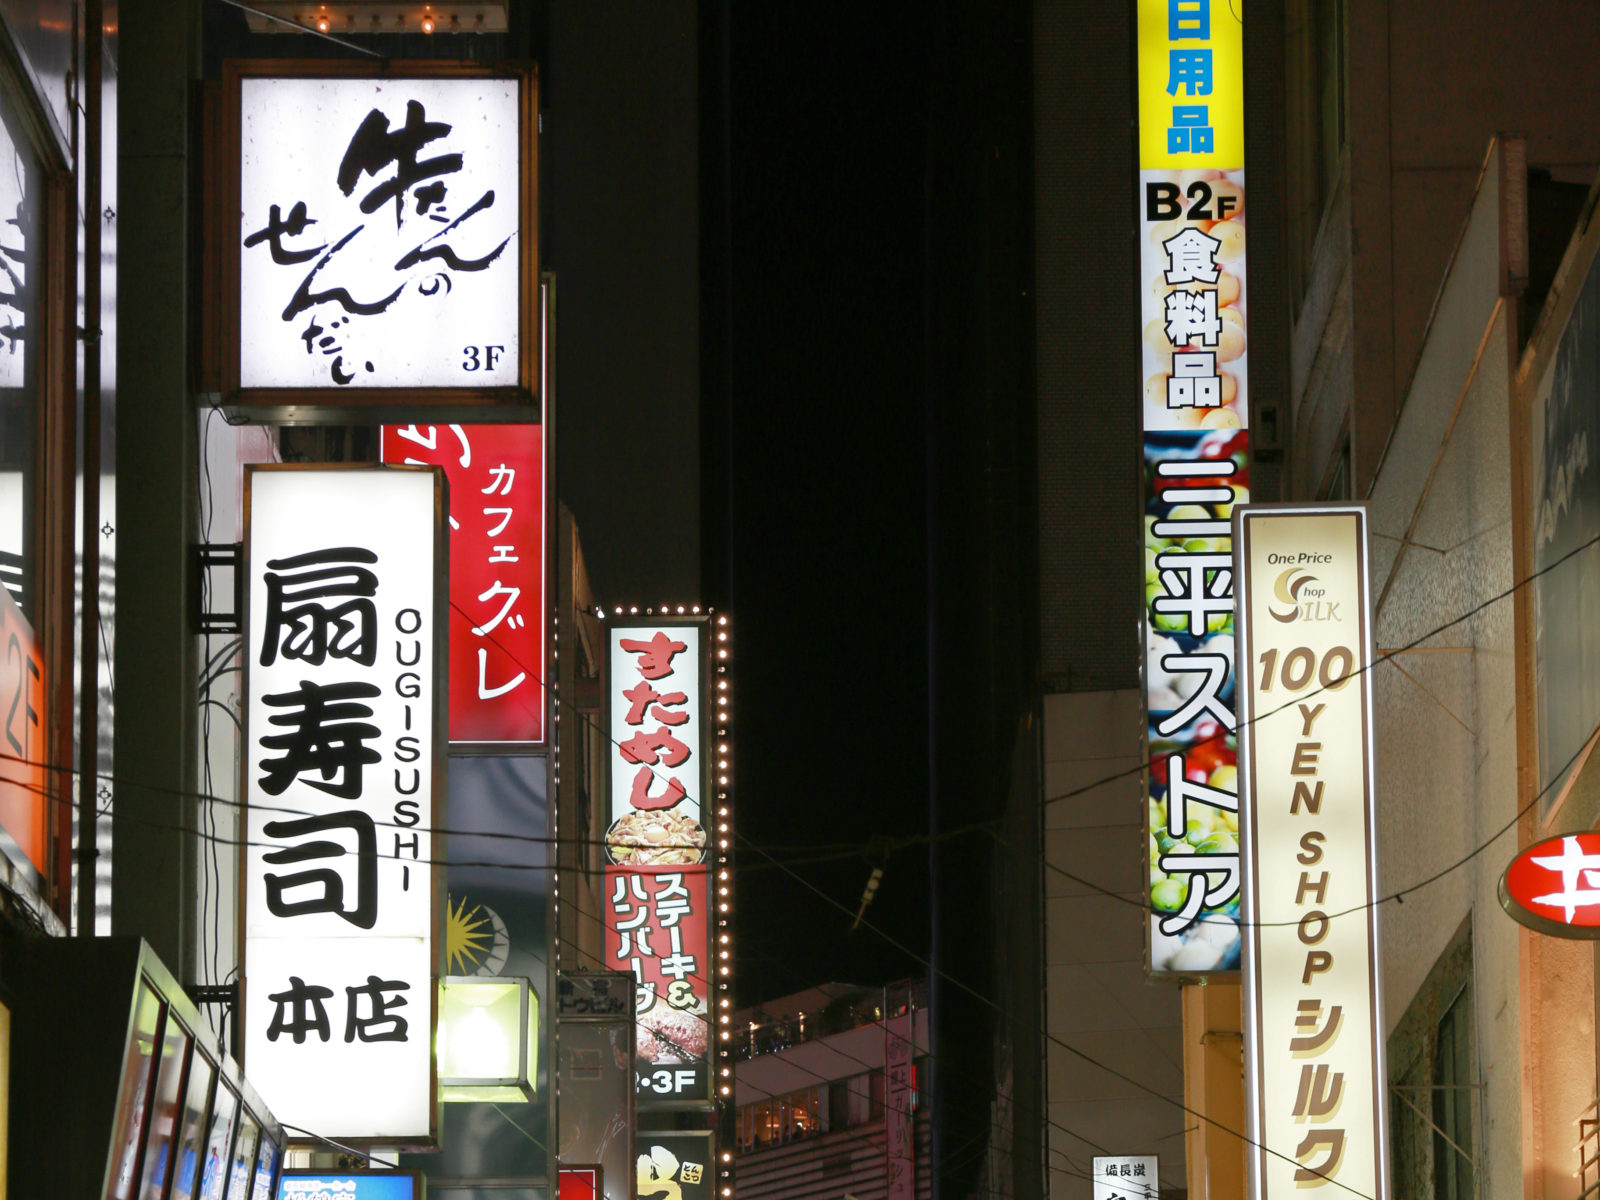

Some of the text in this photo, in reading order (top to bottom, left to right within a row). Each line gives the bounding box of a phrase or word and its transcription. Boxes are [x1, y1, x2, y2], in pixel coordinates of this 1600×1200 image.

[1165, 0, 1215, 155] 日用品
[1145, 181, 1237, 223] B2F
[461, 344, 505, 374] 3F
[1161, 227, 1223, 410] 食料品
[471, 463, 526, 699] カフェグレ
[1267, 552, 1332, 565] One Price
[258, 547, 382, 929] 扇寿司
[394, 608, 421, 891] OUGISUSHI
[1151, 457, 1240, 936] 三平ストア
[1259, 645, 1356, 1189] 100 YEN SHOP シルク
[265, 975, 412, 1045] 本店
[1105, 1164, 1147, 1177] 備長炭
